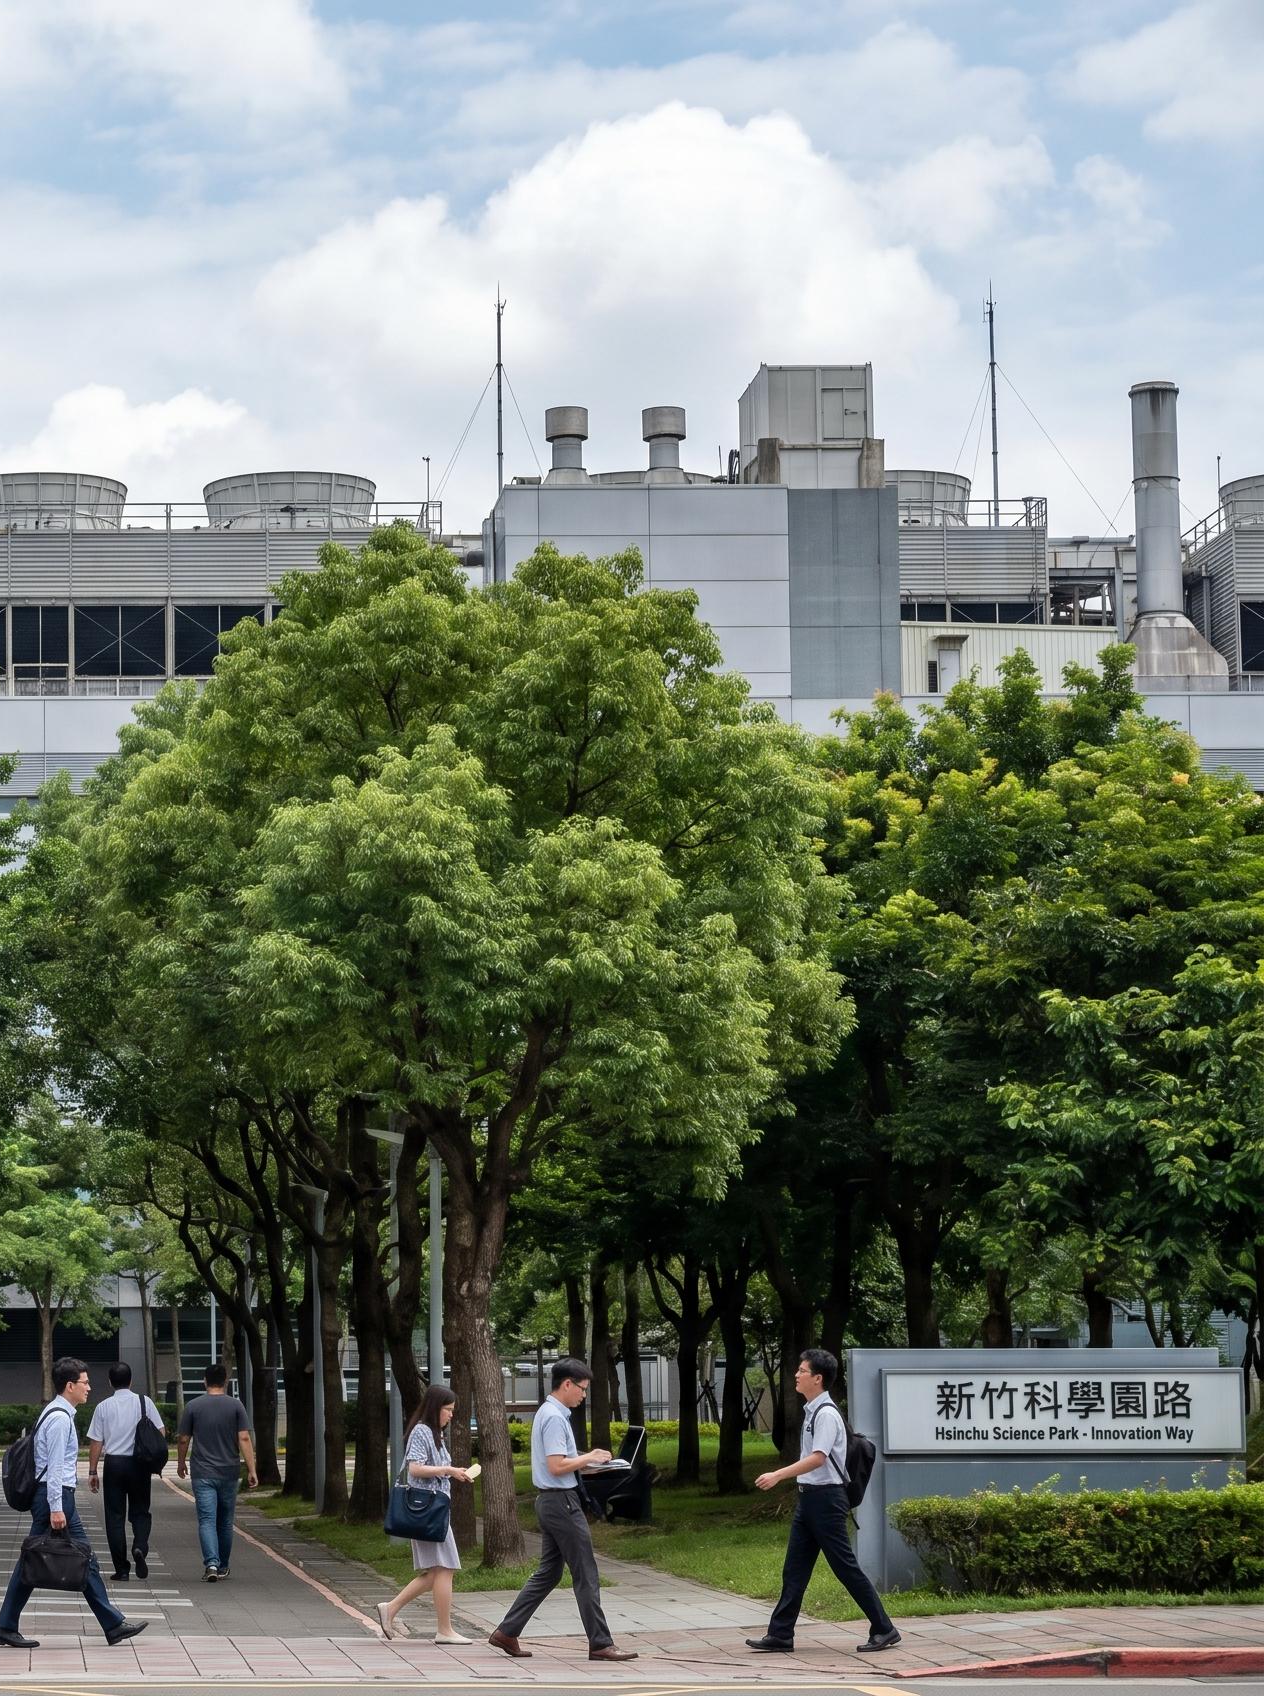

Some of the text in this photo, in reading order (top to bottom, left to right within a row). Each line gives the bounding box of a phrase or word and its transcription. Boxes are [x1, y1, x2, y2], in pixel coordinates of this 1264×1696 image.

[936, 1380, 1193, 1420] 新竹科學園路
[935, 1426, 989, 1441] Hsinchu
[993, 1426, 1045, 1441] Science
[1049, 1426, 1079, 1441] Park
[1091, 1426, 1162, 1441] Innovation
[1165, 1426, 1194, 1444] Way
